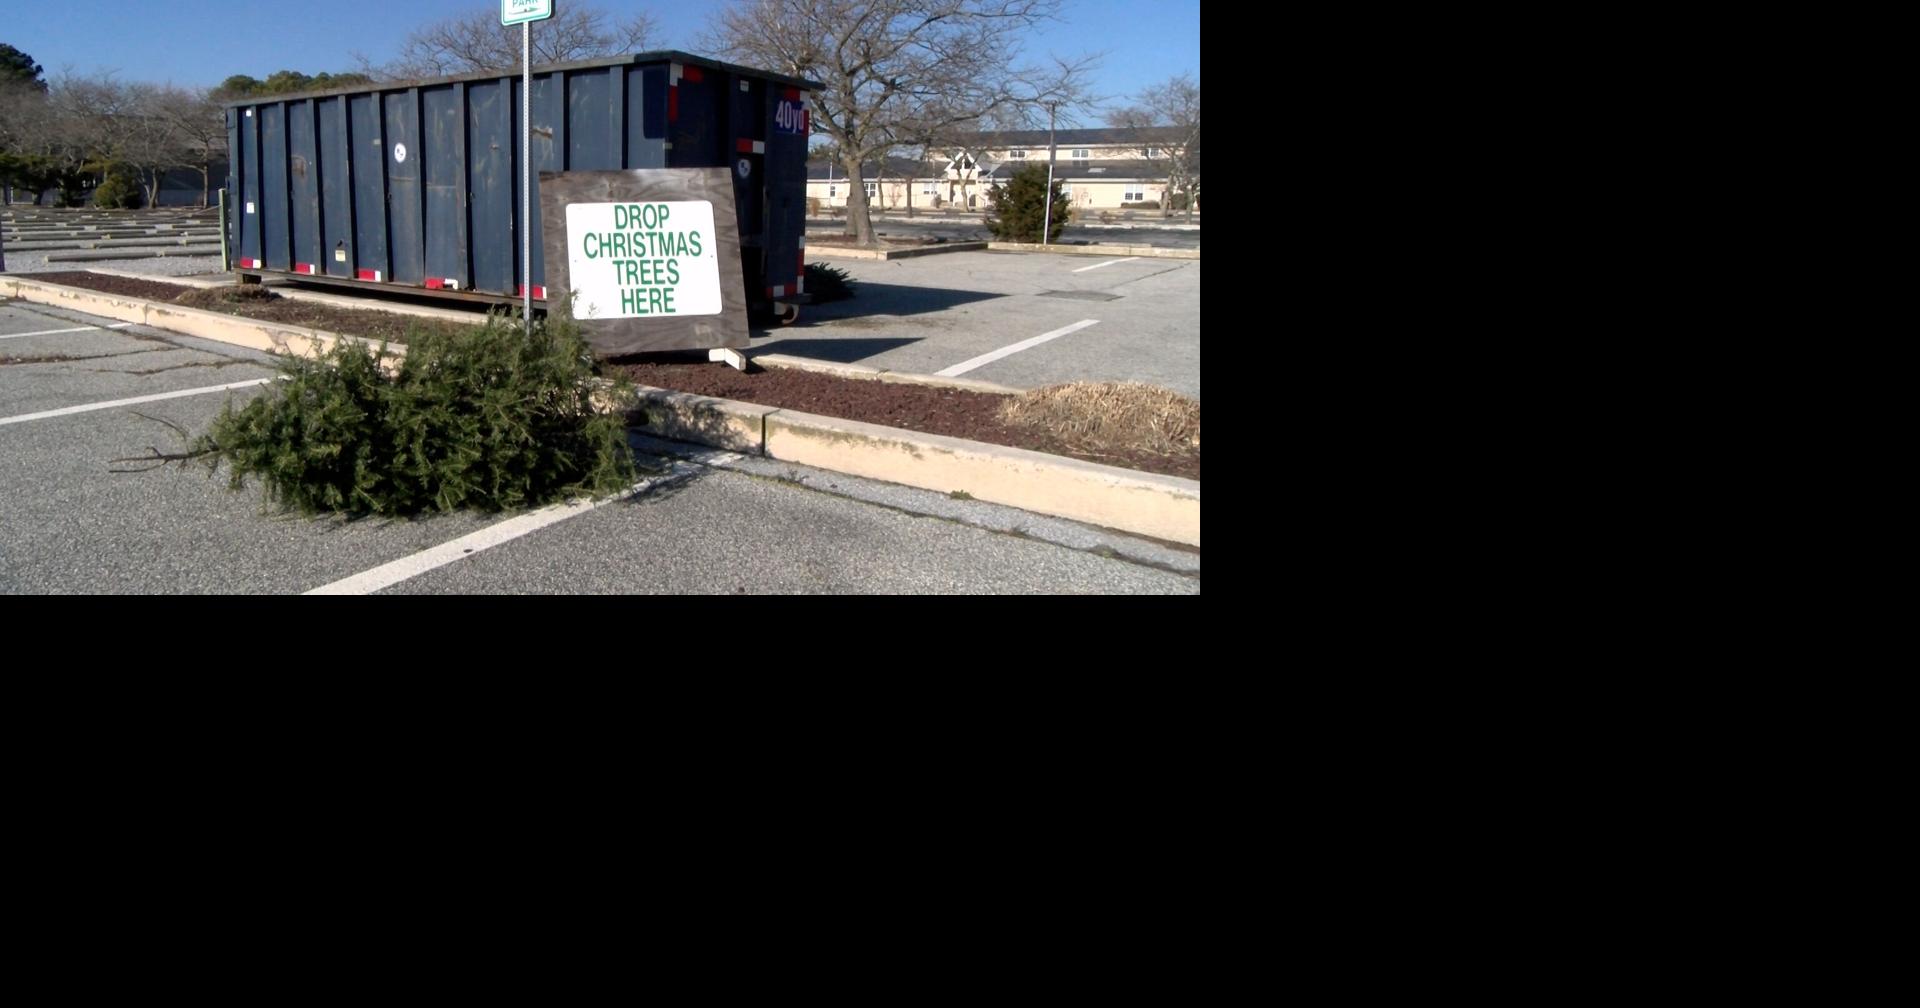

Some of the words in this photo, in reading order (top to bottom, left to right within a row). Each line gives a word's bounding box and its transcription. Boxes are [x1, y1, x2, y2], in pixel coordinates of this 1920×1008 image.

[775, 100, 805, 134] 40yd
[614, 204, 670, 230] DROP
[583, 230, 702, 259] CHRISTMAS
[612, 258, 680, 285] TREES
[621, 287, 676, 314] HERE
